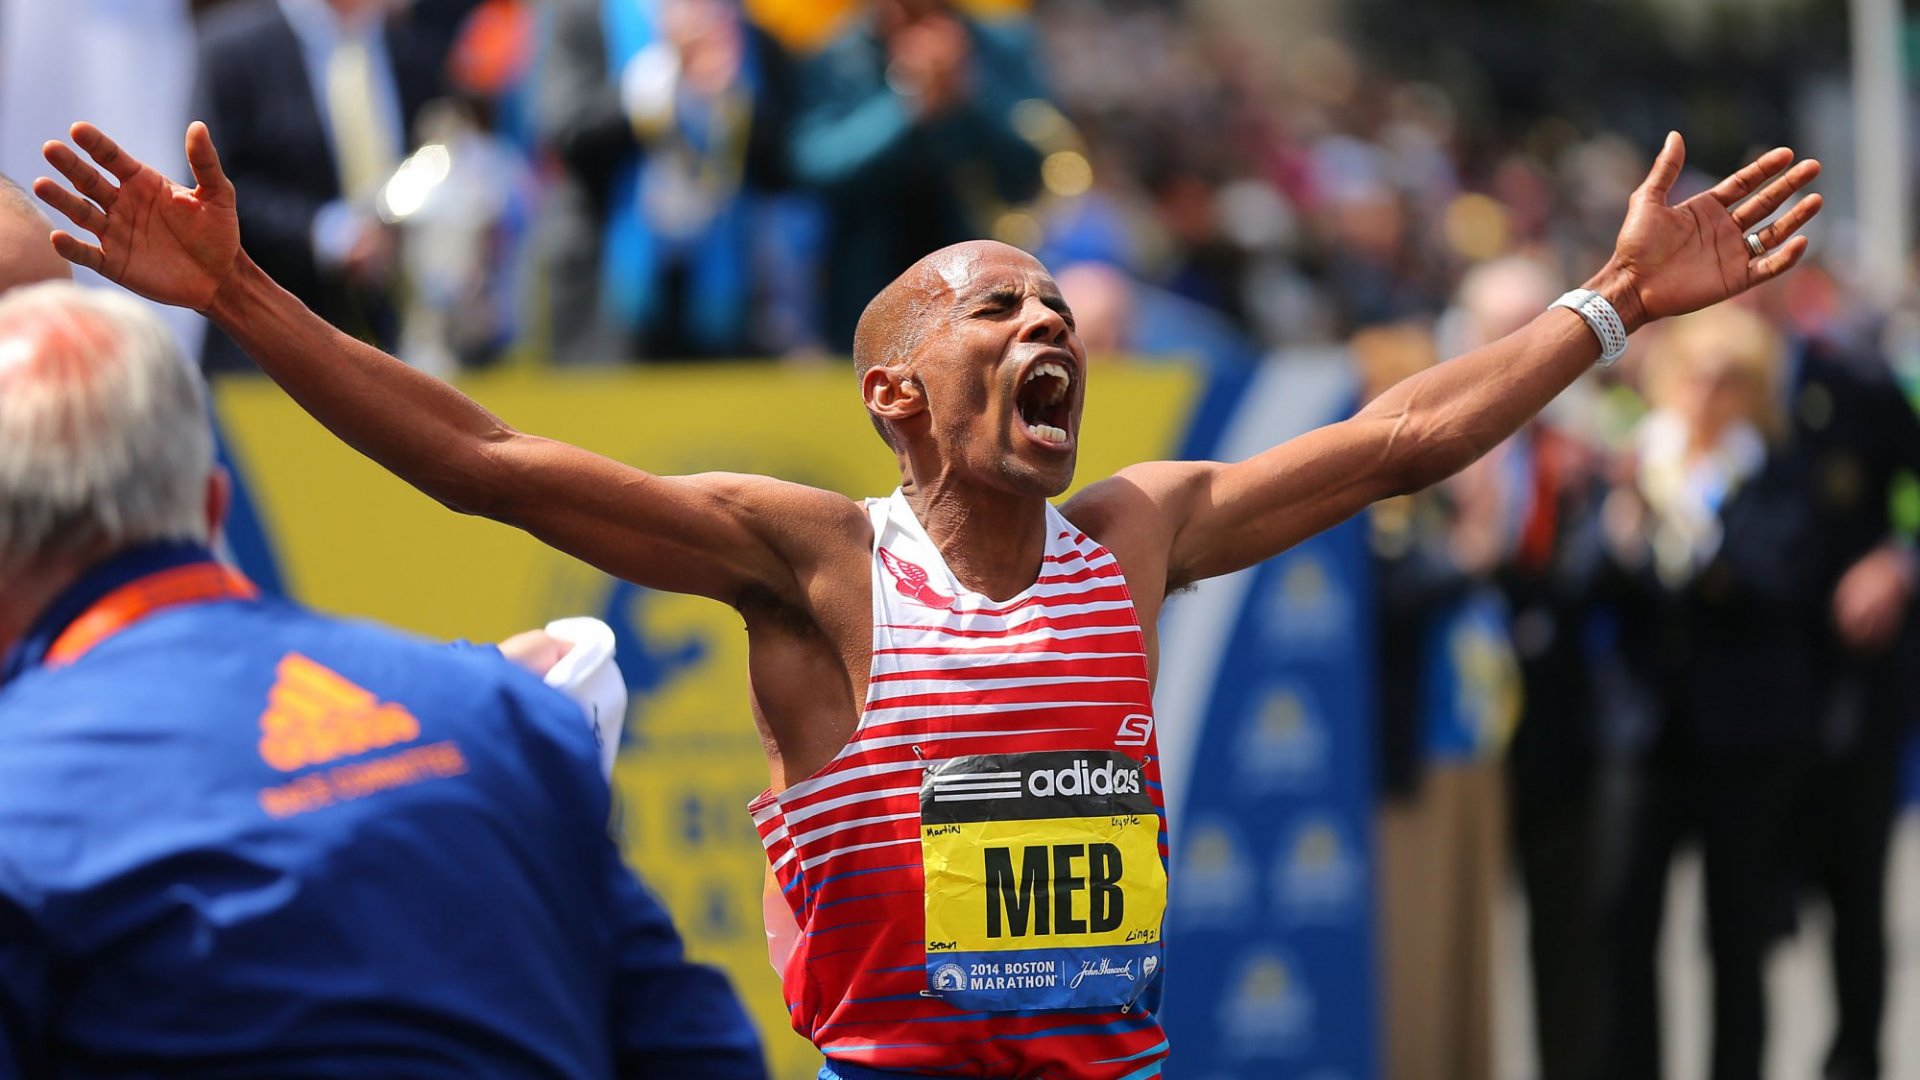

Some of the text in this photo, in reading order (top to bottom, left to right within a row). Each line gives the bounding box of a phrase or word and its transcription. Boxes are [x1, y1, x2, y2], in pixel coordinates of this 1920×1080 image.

[1027, 759, 1141, 797] adidas
[983, 842, 1124, 939] MEB
[970, 960, 1056, 976] 2014 BOSTON
[970, 974, 1056, 991] MARATHON
[1069, 959, 1102, 990] John
